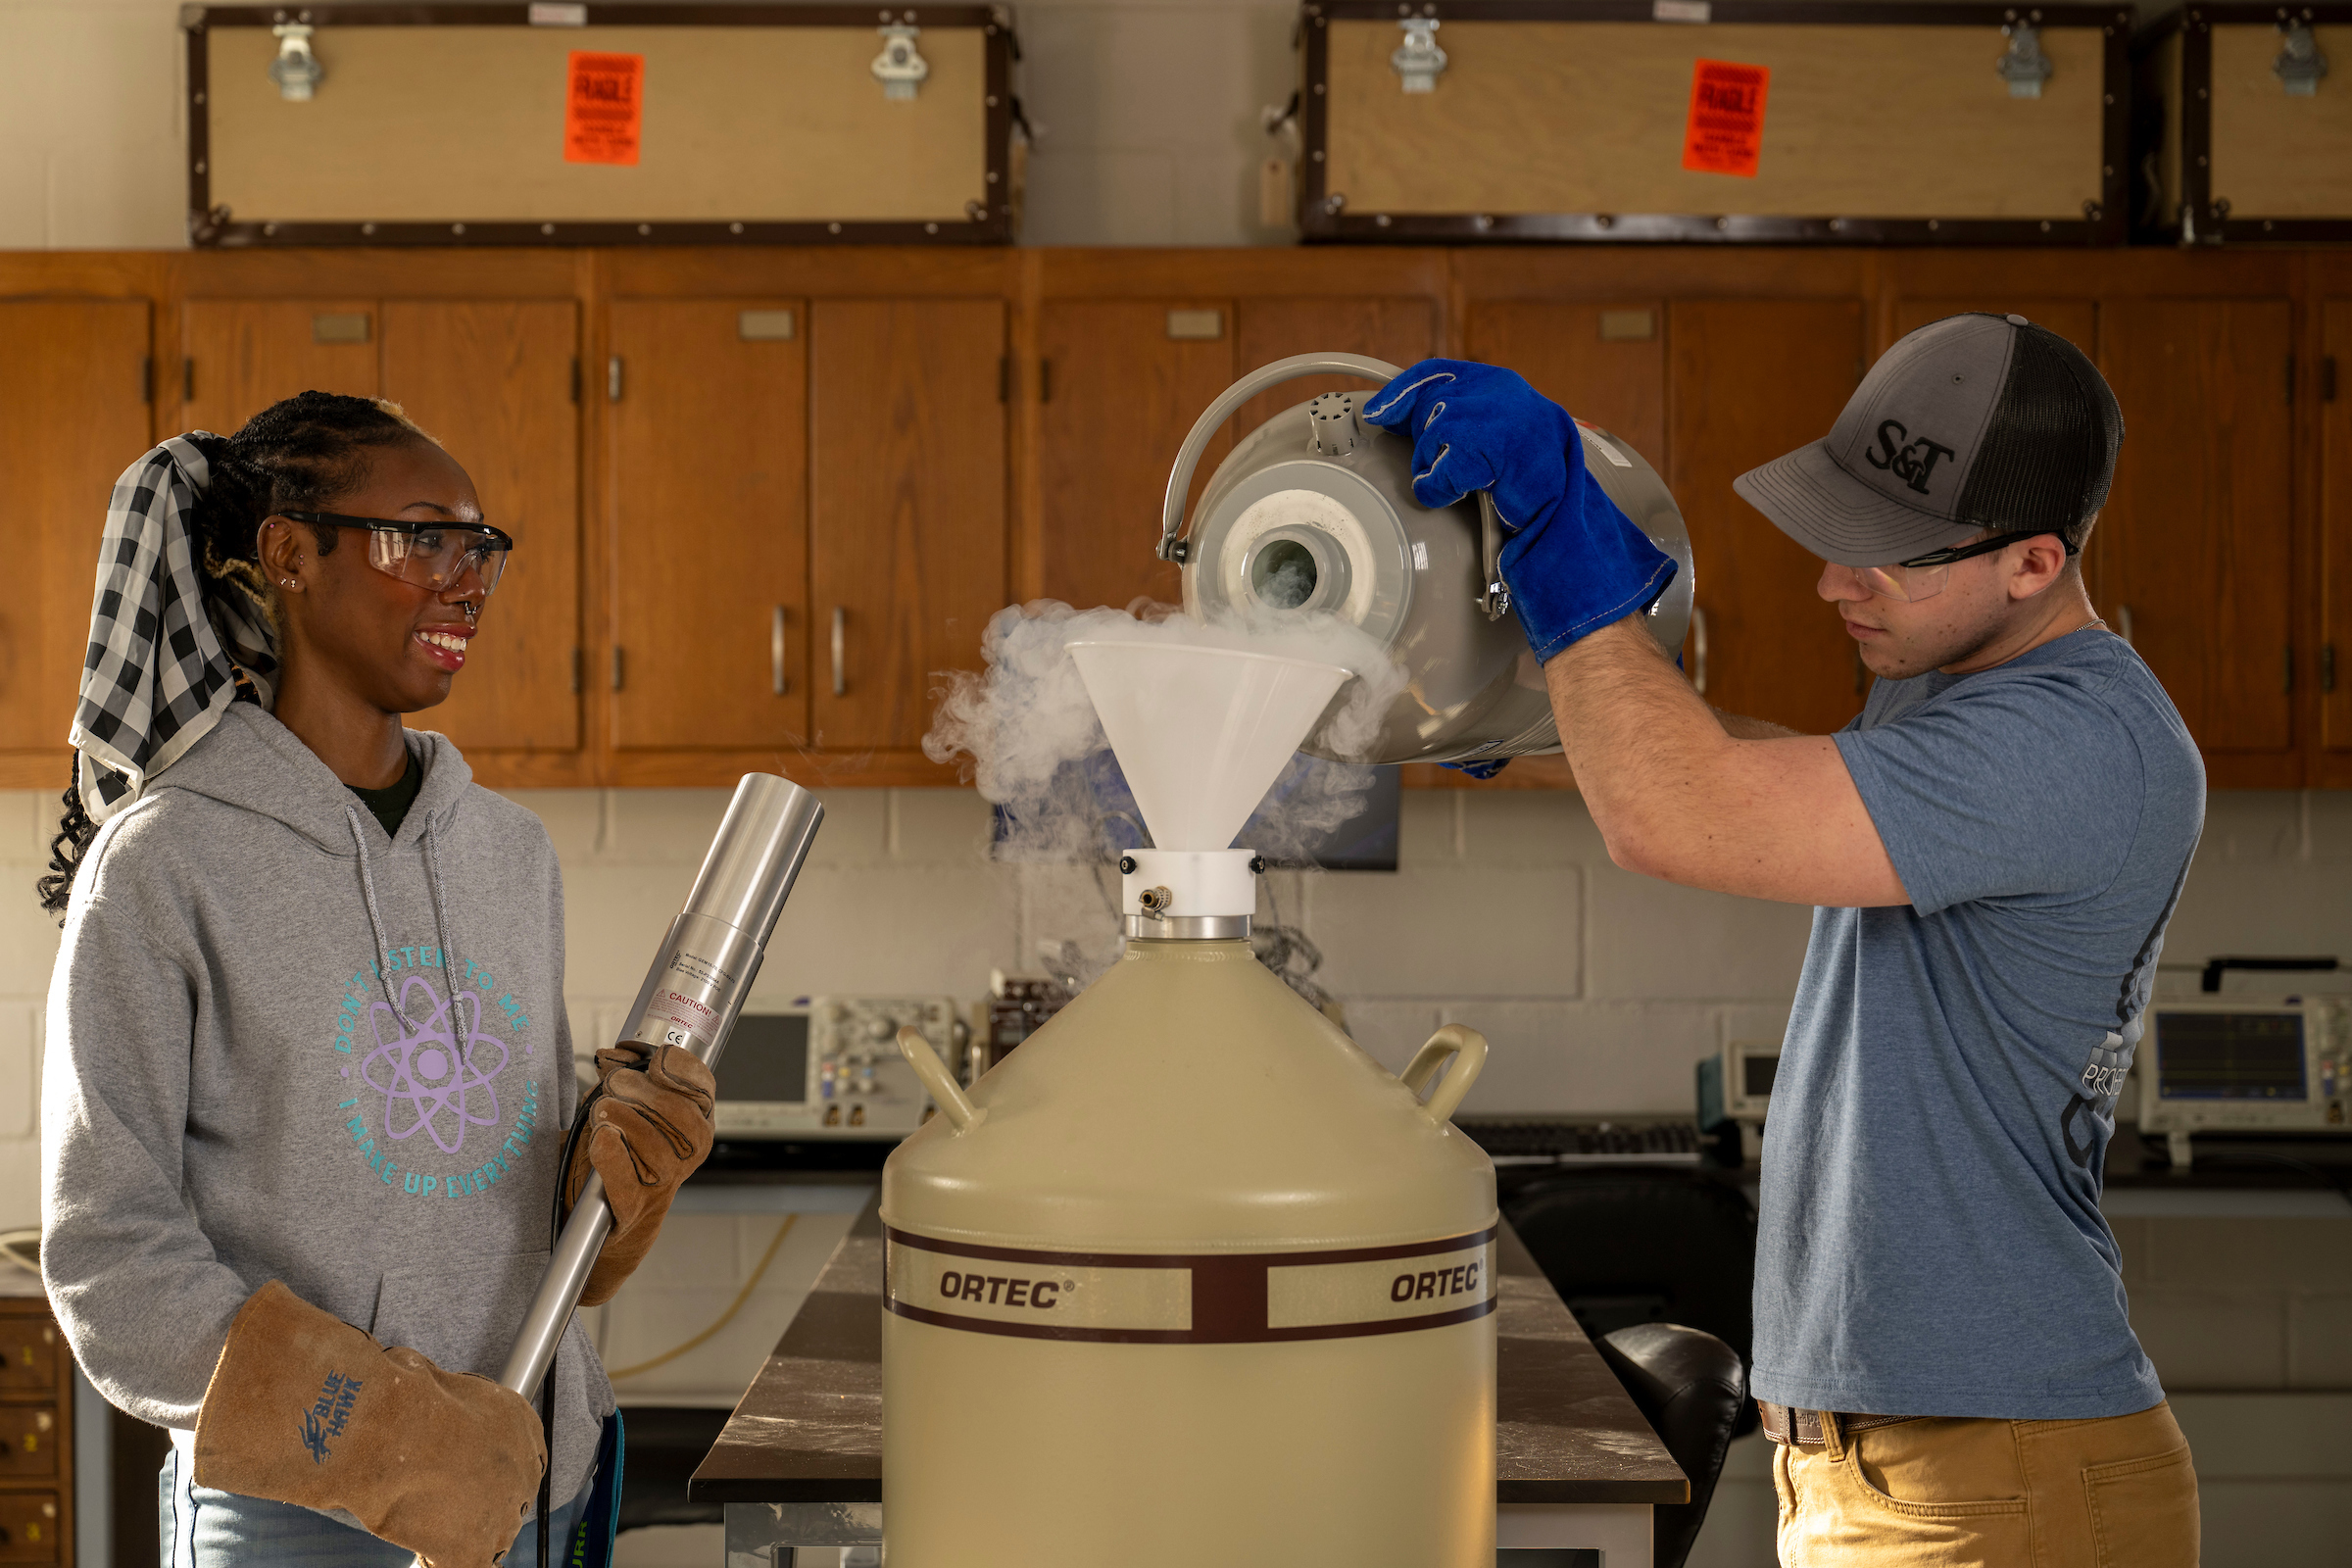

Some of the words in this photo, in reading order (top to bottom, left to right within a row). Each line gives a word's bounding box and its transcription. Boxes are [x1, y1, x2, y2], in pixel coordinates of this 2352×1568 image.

[1865, 418, 1955, 495] S&T
[334, 970, 369, 1054] DON'T
[369, 946, 447, 980] LSTEN
[465, 957, 493, 990] TO
[497, 993, 530, 1032] ME
[669, 992, 712, 1017] CAUTION!
[670, 1015, 694, 1029] ORTEC
[339, 1097, 359, 1109] I
[346, 1114, 398, 1185] MAKE
[445, 1080, 538, 1199] EVERYTHING
[404, 1171, 437, 1197] UP
[313, 1369, 346, 1419] BLUE
[325, 1377, 364, 1438] HAWK
